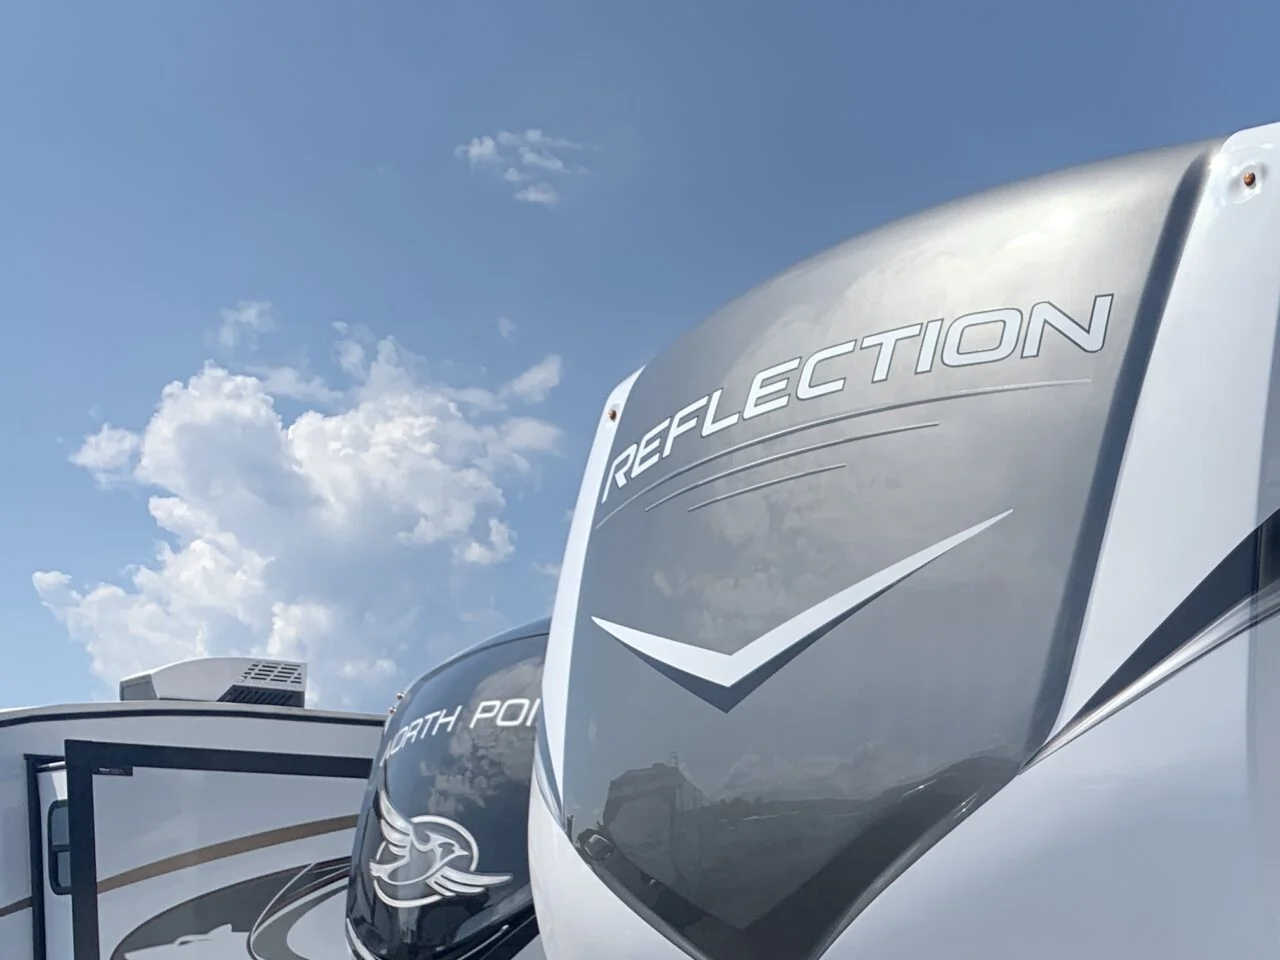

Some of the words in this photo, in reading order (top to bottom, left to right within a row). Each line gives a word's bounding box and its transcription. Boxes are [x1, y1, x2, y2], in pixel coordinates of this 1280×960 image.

[602, 294, 1114, 503] REFLECTION
[379, 705, 463, 767] NORTH
[469, 698, 541, 730] POI
